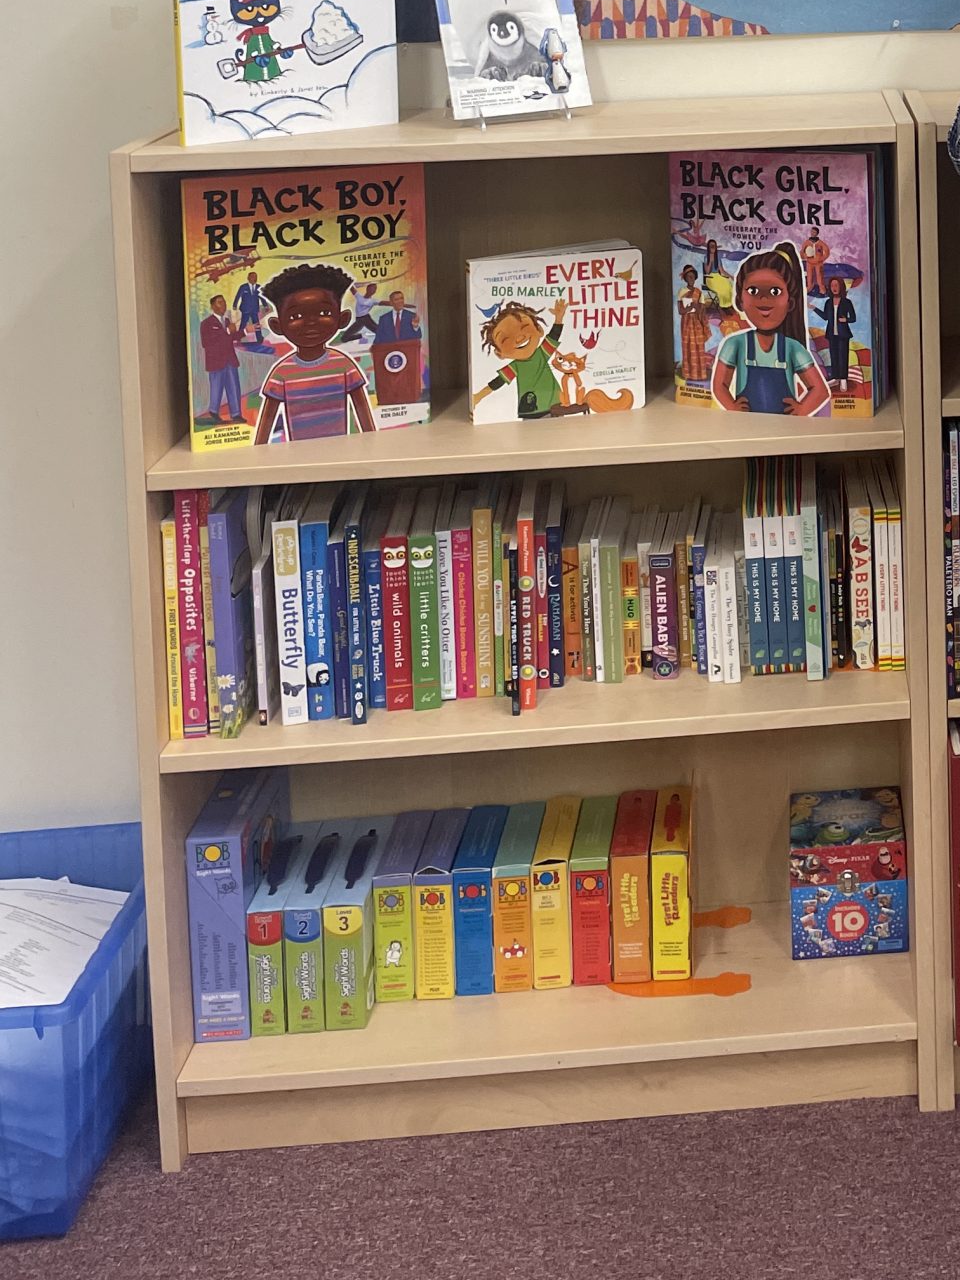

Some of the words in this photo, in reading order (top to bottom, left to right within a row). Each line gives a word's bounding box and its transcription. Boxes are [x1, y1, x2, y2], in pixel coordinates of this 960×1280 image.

[679, 160, 765, 189] BLACK
[203, 185, 325, 220] BLACK
[680, 193, 766, 221] BLACK
[776, 199, 843, 226] GIRL
[205, 219, 325, 255] BLACK
[337, 210, 405, 244] BOY
[344, 252, 388, 262] CELEBRATE
[740, 241, 761, 251] YOU
[353, 260, 381, 269] POWER
[362, 267, 387, 278] YOU
[546, 258, 615, 284] EVERY
[492, 286, 513, 296] BOB
[517, 286, 565, 297] MARLEY
[181, 500, 192, 564] Lift-the-flap
[439, 546, 448, 568] Love
[477, 540, 488, 565] WILL
[855, 556, 868, 567] A
[306, 571, 314, 589] What
[348, 540, 360, 604] INDESCRIBABLE
[440, 571, 448, 588] You
[478, 567, 489, 590] YOU
[855, 572, 868, 584] B
[945, 556, 953, 597] PALETERO
[180, 569, 197, 631] Opposites
[307, 592, 314, 601] Do
[316, 593, 324, 612] Bear,
[368, 584, 381, 617] Little
[392, 593, 403, 616] wild
[419, 591, 430, 619] little
[440, 590, 449, 610] Like
[655, 575, 667, 613] ALIEN
[753, 588, 760, 600] MY
[856, 588, 869, 618] SEE
[307, 604, 315, 617] You
[522, 596, 532, 618] RED
[550, 594, 560, 640] RAMADAN
[627, 599, 635, 618] HUG
[946, 599, 954, 616] MAN
[282, 588, 303, 669] Butterfly
[317, 614, 325, 636] Panda
[441, 612, 449, 626] No
[371, 620, 381, 644] Blue
[442, 628, 450, 653] Otter
[478, 612, 491, 667] SUNSHINE
[523, 623, 533, 660] TRUCK
[657, 616, 669, 655] BABY!
[317, 638, 326, 657] Bear,
[393, 621, 404, 668] animals
[421, 624, 431, 668] critters
[372, 644, 382, 681] Truck
[189, 668, 197, 701] Usborne
[826, 856, 847, 865] Disney
[259, 922, 267, 939] 1
[299, 921, 308, 935] 2
[339, 917, 348, 931] 3
[832, 912, 865, 932] 10
